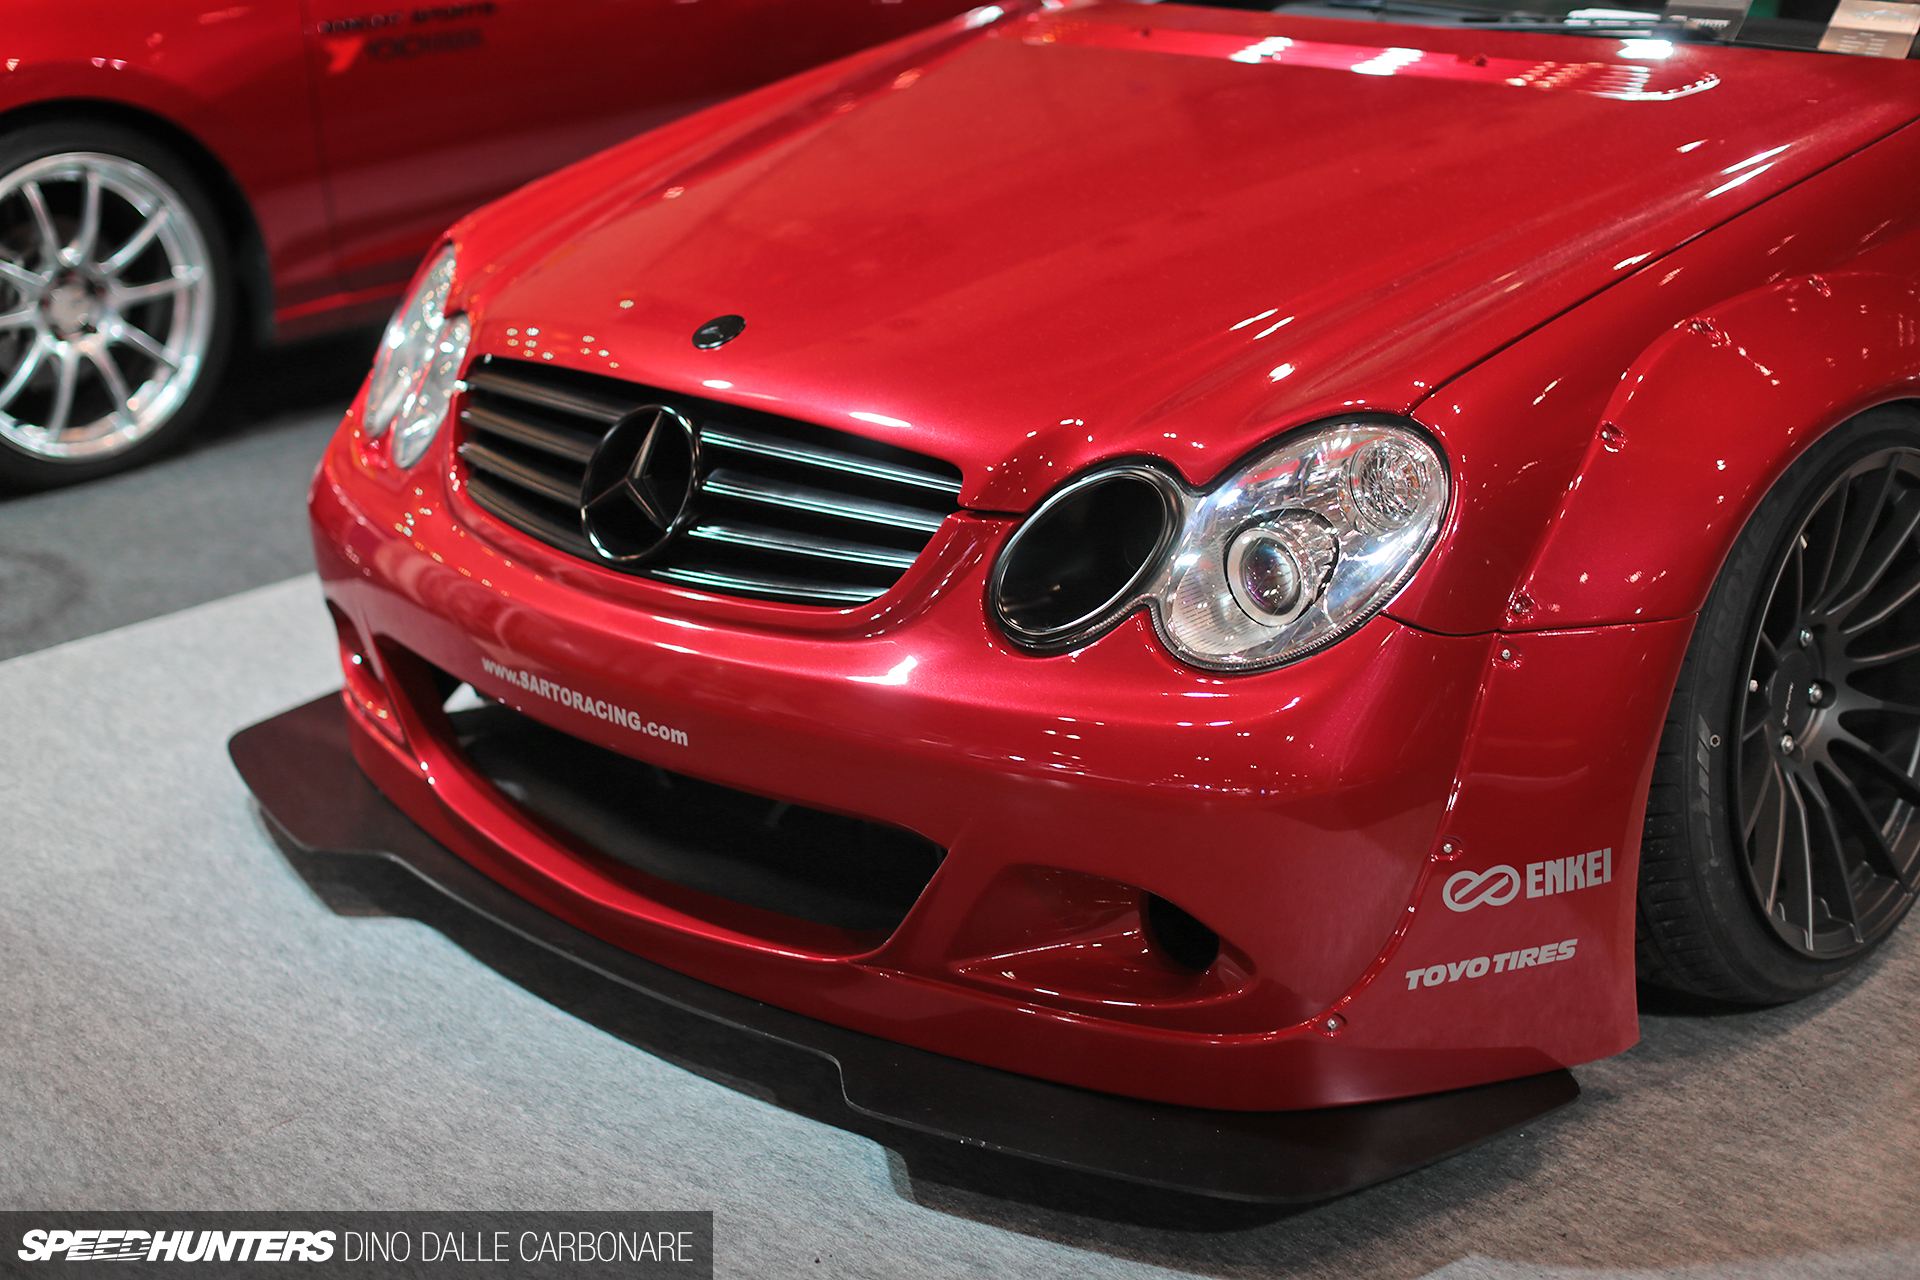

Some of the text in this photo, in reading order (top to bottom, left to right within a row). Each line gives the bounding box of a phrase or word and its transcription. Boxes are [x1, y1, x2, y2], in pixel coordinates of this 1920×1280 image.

[481, 656, 689, 747] www.SARTORACING.com
[1526, 847, 1612, 899] ENKEI
[1405, 938, 1578, 991] TOYO TIRES
